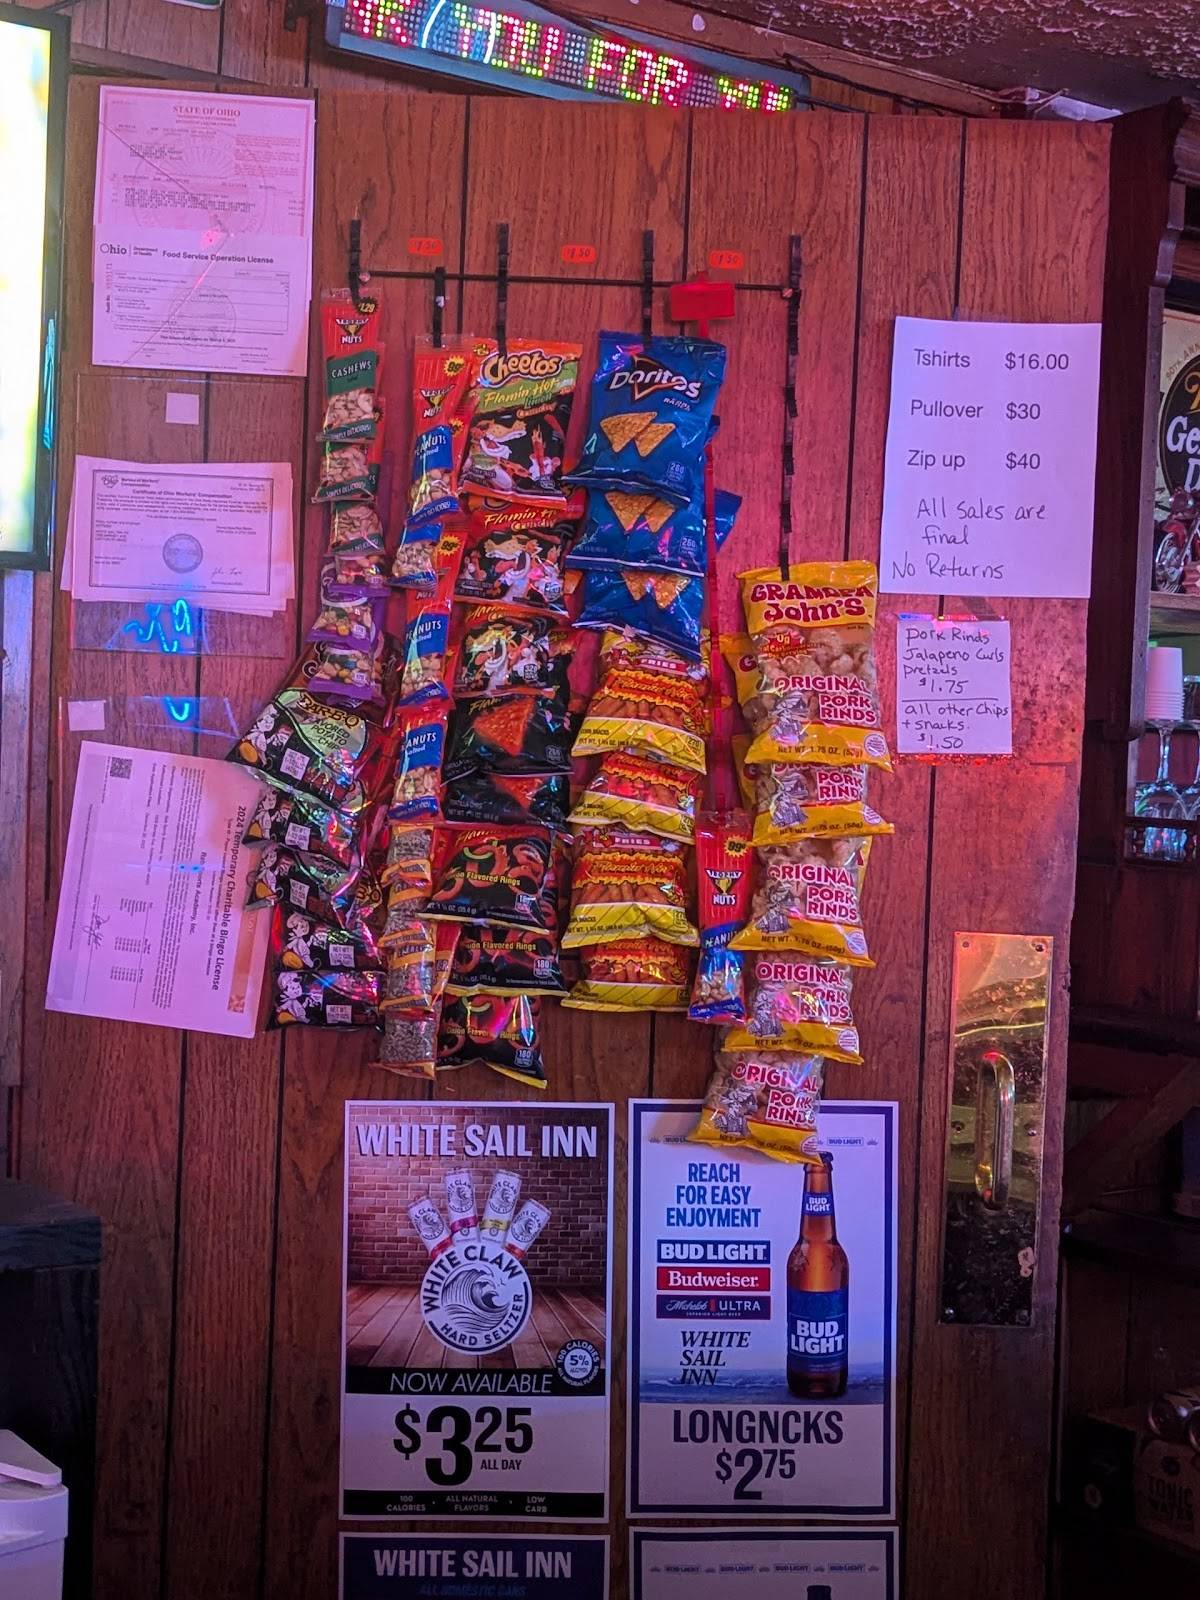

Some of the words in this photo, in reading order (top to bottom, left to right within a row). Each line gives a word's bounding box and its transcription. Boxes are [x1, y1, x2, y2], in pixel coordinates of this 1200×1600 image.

[584, 36, 690, 107] FOR
[173, 105, 200, 115] STATE
[202, 107, 215, 116] OF
[216, 108, 241, 117] OHIO
[99, 243, 127, 255] Ohio
[162, 251, 181, 259] Food
[182, 252, 209, 261] Service
[210, 254, 246, 264] Operation
[247, 256, 274, 264] License
[341, 335, 362, 344] NUTS
[331, 360, 372, 378] CASHEWS
[482, 350, 563, 385] Cheetos
[914, 349, 970, 368] Tshirts
[1004, 351, 1070, 371] $16.00
[609, 367, 703, 400] Doritos
[484, 385, 529, 407] Flamin'
[910, 399, 984, 418] Pullover
[1005, 402, 1041, 421] $30
[907, 449, 936, 471] Zip
[942, 454, 966, 475] up
[1005, 452, 1041, 471] $40
[916, 497, 947, 519] All
[1014, 504, 1046, 521] are
[921, 524, 969, 546] final
[892, 551, 917, 580] No
[925, 552, 1005, 579] Returns
[951, 627, 990, 645] Rinds
[640, 658, 678, 669] FRIES
[903, 647, 970, 665] Jalapeno
[975, 647, 1005, 662] Curls
[919, 678, 969, 694] $1.75
[819, 694, 871, 709] PORK
[904, 702, 931, 716] all
[937, 703, 973, 717] other
[819, 707, 876, 723] RINDS
[310, 725, 347, 746] POTATO
[917, 733, 964, 751] $1.50
[817, 772, 864, 788] PORK
[235, 806, 247, 827] 2024
[614, 837, 650, 845] FRIES
[227, 830, 243, 878] Temporary
[466, 872, 498, 883] Flavored
[499, 874, 521, 886] Rings
[221, 881, 236, 927] Charitable
[713, 894, 736, 905] NUTS
[807, 886, 857, 905] PORK
[191, 890, 202, 922] Academy,
[806, 902, 857, 922] RINDS
[216, 929, 228, 955] Bingo
[482, 942, 514, 951] Flavored
[515, 942, 536, 951] Rings
[761, 935, 776, 944] NET
[536, 959, 550, 968] 180
[212, 957, 223, 990] License
[799, 987, 847, 1003] PORK
[800, 1002, 850, 1019] RINDS
[770, 1091, 813, 1109] PORK
[356, 1123, 456, 1157] WHITE
[464, 1124, 533, 1157] SAIL
[541, 1125, 597, 1158] INN
[687, 1163, 740, 1183] REACH
[676, 1185, 708, 1205] FOR
[711, 1185, 751, 1205] EASY
[809, 1196, 828, 1205] BUD
[805, 1203, 831, 1212] LIGHT
[666, 1208, 761, 1228] ENJOYMENT
[660, 1243, 704, 1260] BUD
[706, 1243, 767, 1260] LIGHT
[422, 1250, 461, 1314] WHITE
[464, 1246, 524, 1280] CLAW
[668, 1270, 759, 1288] Budweiser
[719, 1300, 761, 1311] ULTRA
[440, 1323, 478, 1346] HARD
[484, 1293, 524, 1345] SELTZER
[796, 1319, 840, 1338] BUD
[680, 1331, 751, 1349] WHITE
[790, 1335, 845, 1355] LIGHT
[556, 1349, 567, 1363] 100
[566, 1340, 600, 1362] CALORIES
[569, 1354, 590, 1366] 5%
[679, 1350, 726, 1367] SAIL
[389, 1372, 449, 1393] NOW
[450, 1373, 554, 1394] AVAILABLE
[680, 1368, 719, 1386] INN
[673, 1409, 844, 1445] LONGNCKS
[480, 1459, 499, 1470] ALL
[501, 1459, 522, 1471] DAY
[386, 1503, 427, 1512] CALORIES
[454, 1504, 490, 1512] FLAVORS
[525, 1505, 548, 1513] CARB
[446, 1495, 461, 1503] ALL
[462, 1495, 498, 1503] NATURAL
[526, 1496, 546, 1504] LOW
[373, 1549, 456, 1578] WHITE
[462, 1550, 519, 1578] SAIL
[525, 1552, 572, 1579] INN
